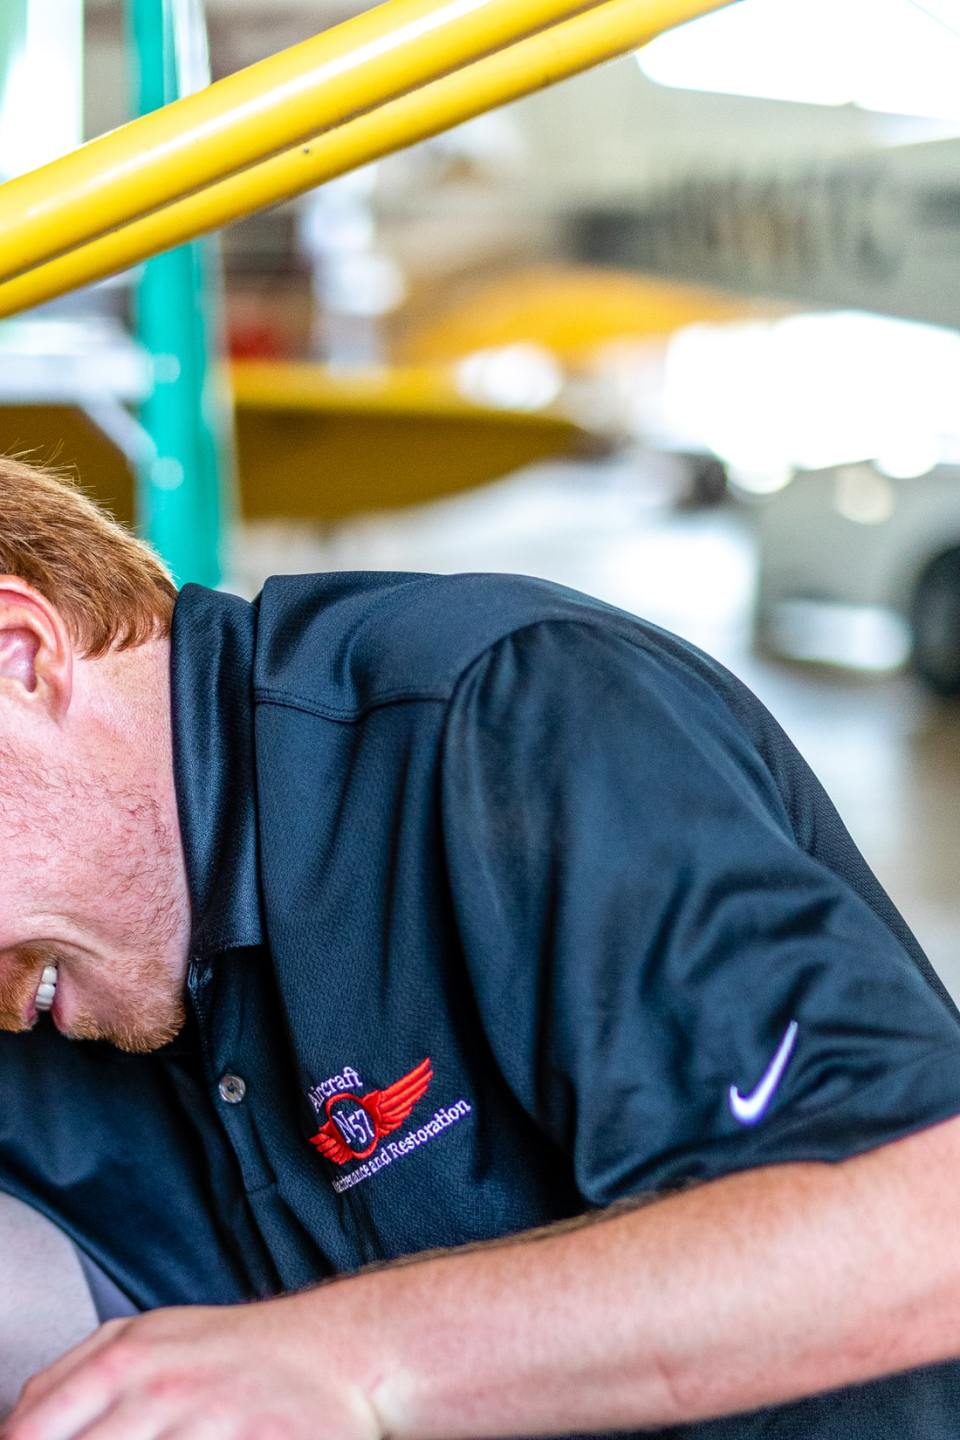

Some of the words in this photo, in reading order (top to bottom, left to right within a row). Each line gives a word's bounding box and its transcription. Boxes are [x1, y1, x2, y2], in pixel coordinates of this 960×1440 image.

[308, 1066, 363, 1113] Aircraft
[332, 1108, 375, 1144] N57
[368, 1147, 391, 1173] and
[388, 1099, 471, 1160] Restoration
